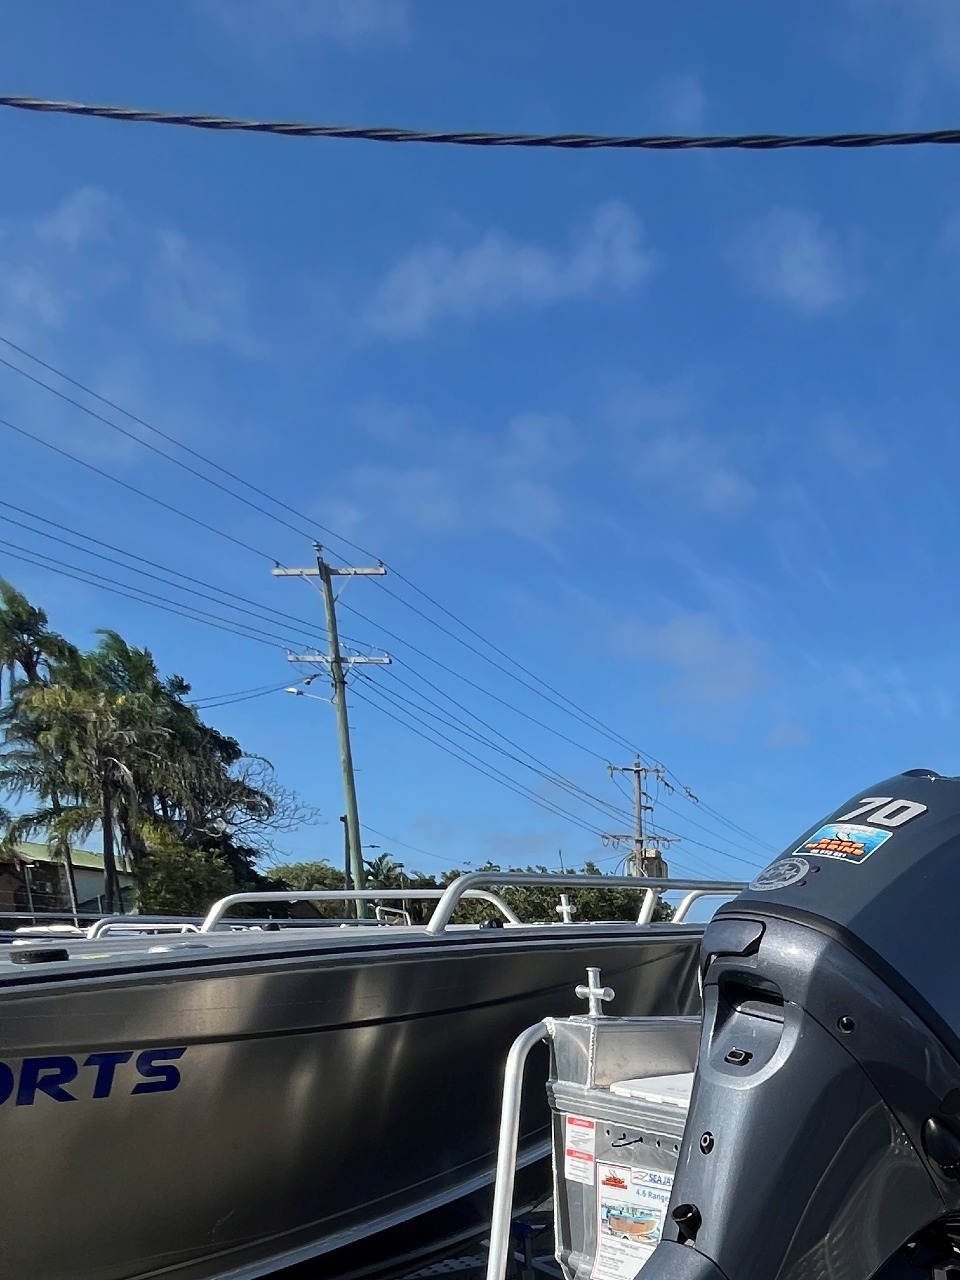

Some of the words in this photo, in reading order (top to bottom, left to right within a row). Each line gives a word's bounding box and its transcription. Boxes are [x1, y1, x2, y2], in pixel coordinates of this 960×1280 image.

[836, 796, 928, 827] 70
[0, 1046, 188, 1107] RTS
[649, 1173, 662, 1185] SEA
[662, 1176, 673, 1187] JA
